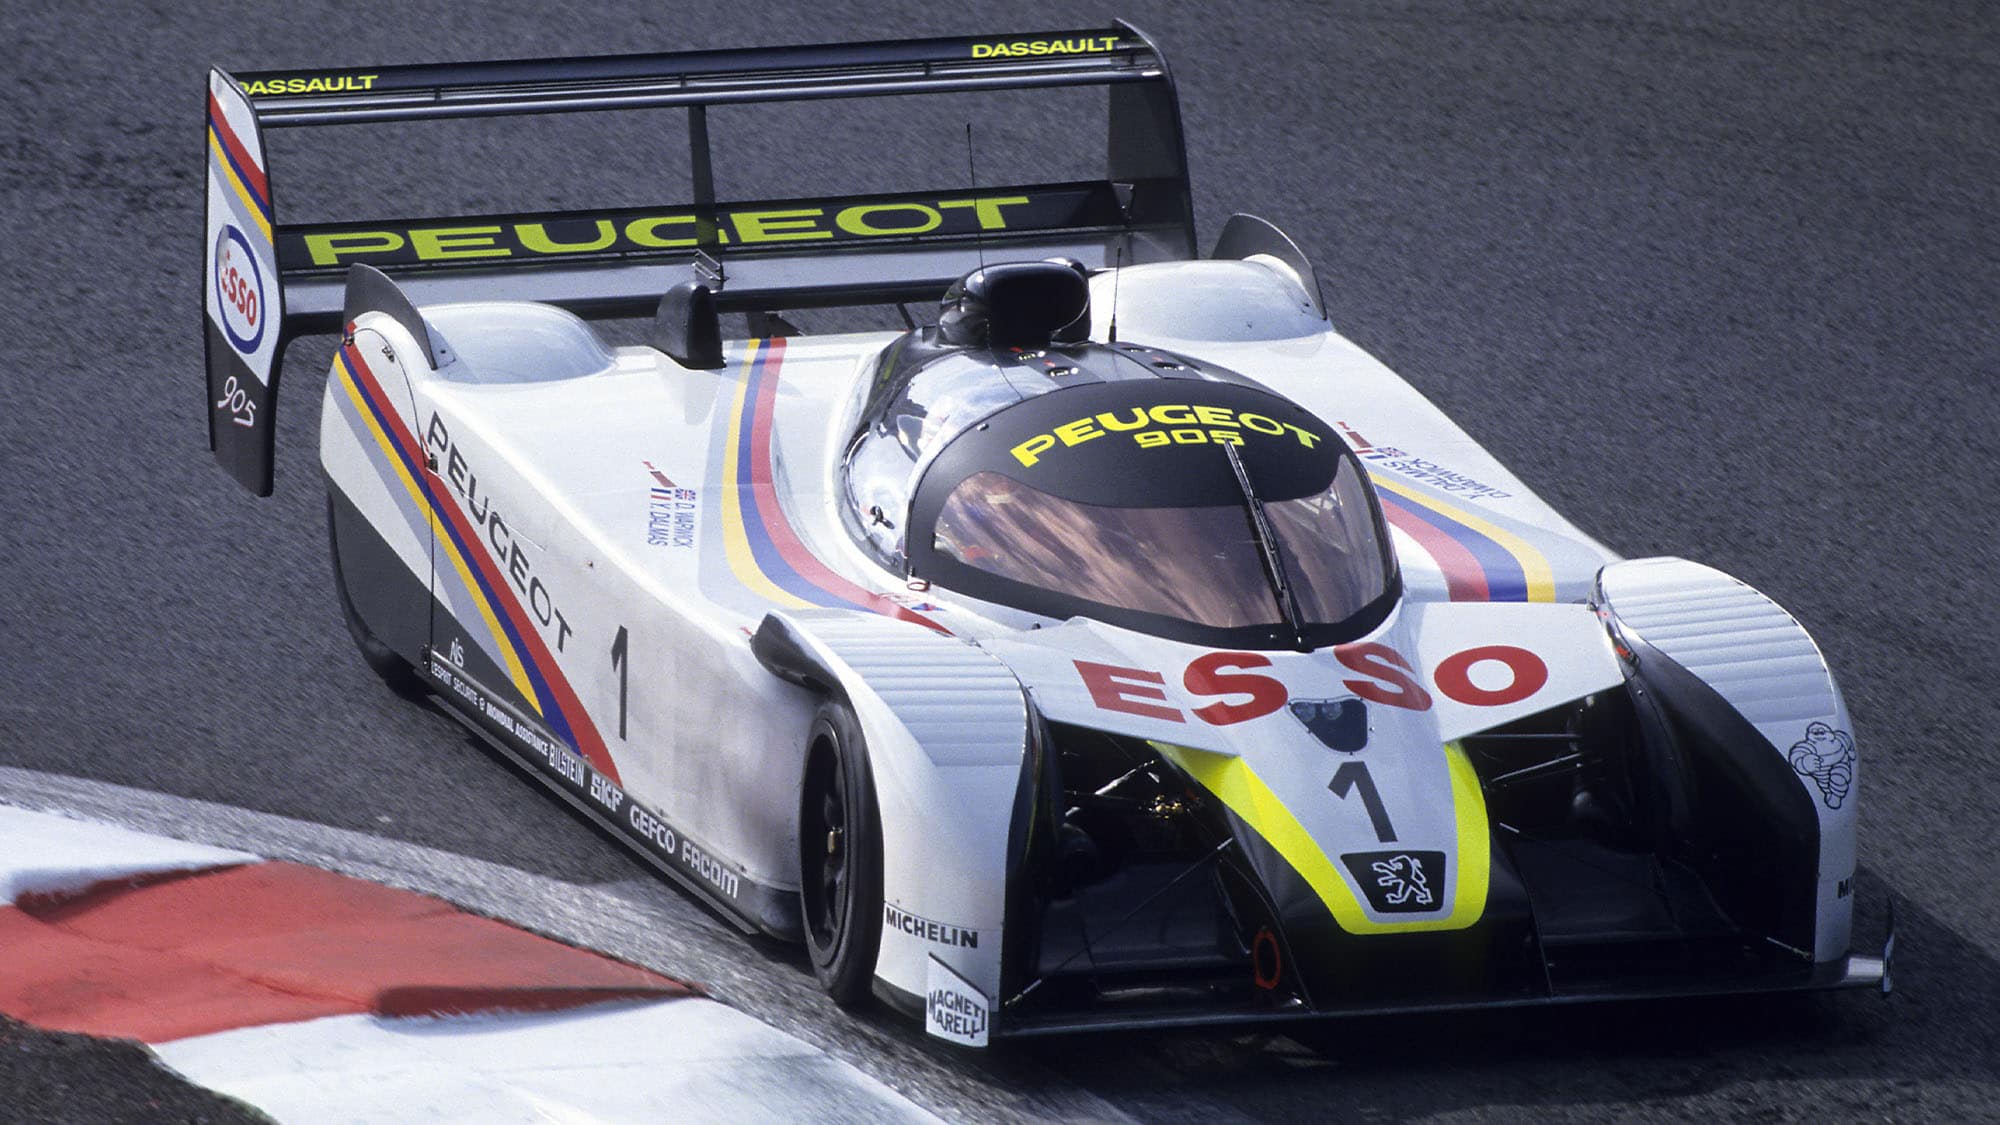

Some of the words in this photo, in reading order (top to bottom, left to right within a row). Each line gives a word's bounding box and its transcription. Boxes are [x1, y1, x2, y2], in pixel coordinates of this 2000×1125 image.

[972, 36, 1119, 58] DASSAULT
[304, 196, 1029, 265] PEUGEOT
[218, 376, 256, 427] 905
[1010, 405, 1321, 467] PEUGEOT
[1134, 429, 1245, 448] 905
[427, 410, 572, 653] PEUGEOT
[647, 511, 671, 546] DALMAS
[611, 624, 628, 742] 1
[1072, 641, 1549, 726] ESSO
[515, 722, 549, 757] ASSISTANCE
[549, 743, 585, 787] BILSTEIN
[590, 772, 624, 812] SKF
[1327, 761, 1398, 843] 1
[629, 805, 676, 854] GEFCO
[682, 840, 739, 899] FACOM
[886, 907, 979, 949] MICHELIN
[928, 989, 986, 1026] MAGNETI
